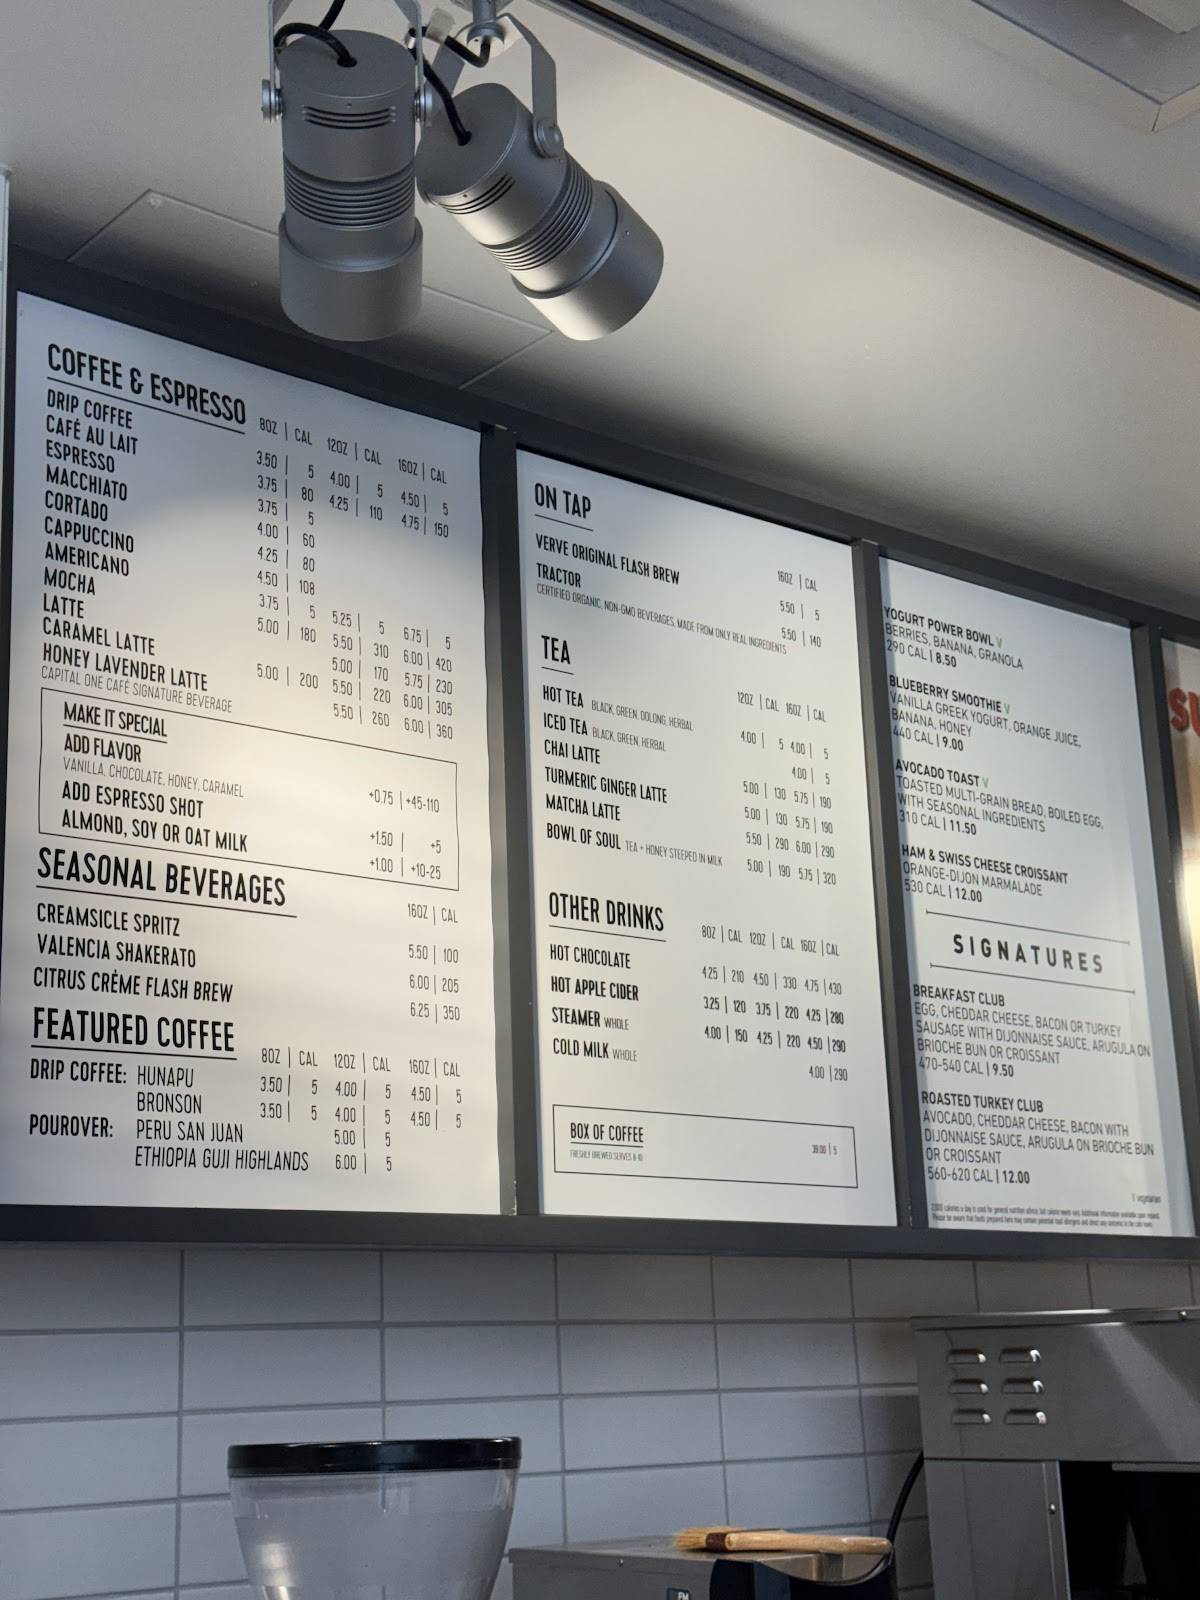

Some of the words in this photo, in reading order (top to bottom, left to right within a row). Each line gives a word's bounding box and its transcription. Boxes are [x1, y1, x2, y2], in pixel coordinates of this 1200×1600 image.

[47, 343, 123, 390] COFFEE
[129, 367, 144, 395] &
[150, 372, 246, 425] ESPRESSO
[47, 388, 79, 414] DRIP
[83, 399, 133, 430] COFFEE
[85, 425, 105, 447] AU
[110, 431, 139, 455] LAIT
[294, 427, 313, 446] CAL
[364, 448, 382, 466] CAL
[46, 439, 115, 473] ESPRESSO
[46, 463, 128, 502] MACCHIATO
[256, 449, 278, 470] 3.50
[329, 471, 351, 489] 4.00
[400, 490, 420, 509] 4.50
[44, 489, 108, 522] CORTADO
[534, 482, 558, 511] ON
[562, 489, 592, 519] TAP
[44, 515, 134, 554] CAPPUCCINO
[44, 541, 130, 577] AMERICANO
[535, 533, 569, 557] VERVE
[571, 543, 618, 570] ORIGINAL
[620, 556, 650, 578] FLASH
[652, 564, 680, 585] BREW
[44, 566, 96, 596] MOCHA
[536, 562, 581, 589] TRACTOR
[804, 577, 818, 593] CAL
[43, 592, 84, 619] LATTE
[43, 616, 111, 647] CARAMEL
[116, 631, 155, 656] LATTE
[883, 606, 925, 628] YOGURT
[927, 617, 964, 639] POWER
[965, 628, 995, 647] BOWL
[541, 634, 571, 665] TEA
[885, 622, 931, 647] BERRIES,
[933, 634, 977, 659] BANANA,
[978, 647, 1024, 670] GRANOLA
[886, 638, 906, 655] 290
[907, 644, 928, 661] CAL
[935, 651, 957, 668] 8.50
[43, 642, 90, 669] HONEY
[95, 652, 166, 684] LAVENDER
[170, 667, 208, 692] LATTE
[41, 664, 81, 686] CAPITAL
[84, 672, 104, 690] ONE
[132, 681, 184, 705] SIGNATURE
[186, 691, 232, 714] BEVERAGE
[542, 684, 562, 704] HOT
[565, 689, 584, 709] TEA
[889, 674, 949, 700] BLUEBERRY
[951, 689, 1002, 714] SMOOTHIE
[64, 701, 101, 726] MAKE
[104, 708, 116, 728] IT
[118, 711, 168, 738] SPECIAL
[371, 710, 390, 727] 260
[436, 723, 453, 740] 360
[543, 712, 567, 732] ICED
[569, 717, 588, 736] TEA
[64, 732, 90, 755] ADD
[93, 737, 142, 763] FLAVOR
[544, 738, 569, 759] CHAI
[571, 744, 601, 765] LATTE
[942, 735, 964, 752] 9.00
[544, 766, 597, 791] TURMERIC
[600, 776, 637, 798] GINGER
[639, 784, 668, 804] LATTE
[895, 759, 945, 780] AVOCADO
[946, 769, 980, 787] TOAST
[62, 780, 91, 802] ADD
[96, 784, 165, 814] ESPRESSO
[169, 796, 204, 819] SHOT
[545, 793, 589, 816] MATCHA
[592, 801, 621, 822] LATTE
[897, 792, 924, 809] WITH
[926, 797, 981, 821] SEASONAL
[982, 809, 1046, 833] INGREDIENTS
[61, 808, 128, 838] ALMOND,
[131, 818, 158, 840] SOY
[162, 823, 180, 844] OR
[185, 826, 211, 847] OAT
[215, 830, 247, 853] MILK
[546, 822, 577, 843] BOWL
[580, 827, 593, 845] OF
[595, 830, 622, 850] SOUL
[949, 819, 977, 836] 11.50
[37, 846, 157, 891] SEASONAL
[165, 863, 286, 907] BEVERAGES
[901, 844, 926, 860] HAM
[928, 848, 936, 862] &
[938, 850, 972, 868] SWISS
[973, 856, 1013, 875] CHEESE
[1014, 863, 1068, 884] CROISSANT
[902, 860, 980, 886] ORANGE-DIJON
[981, 874, 1043, 897] MARMALADE
[955, 886, 983, 903] 12.00
[37, 902, 128, 932] CREAMSICLE
[133, 913, 180, 937] SPRITZ
[549, 891, 600, 923] OTHER
[606, 899, 664, 932] DRINKS
[37, 933, 111, 960] VALENCIA
[115, 941, 196, 968] SHAKERATO
[408, 943, 429, 961] 5.50
[443, 947, 459, 964] 100
[549, 943, 570, 962] HOT
[573, 946, 631, 969] CHOCOLATE
[953, 933, 1103, 974] SIGNATURES
[33, 966, 86, 991] CITRUS
[145, 976, 189, 1000] FLASH
[193, 980, 233, 1003] BREW
[551, 975, 571, 994] HOT
[574, 978, 606, 998] APPLE
[609, 982, 639, 1001] CIDER
[702, 965, 718, 981] 4.25
[731, 969, 745, 984] 210
[913, 984, 976, 1004] BREAKFAST
[978, 991, 1006, 1007] CLUB
[33, 1006, 148, 1046] FEATURED
[157, 1016, 235, 1052] COFFEE
[551, 1006, 601, 1028] STEAMER
[603, 1016, 629, 1031] WHOLE
[552, 1037, 580, 1057] COLD
[583, 1040, 609, 1059] MILK
[611, 1048, 637, 1062] WHOLE
[916, 1037, 963, 1056] BRIOCHE
[964, 1042, 987, 1058] BUN
[989, 1044, 1004, 1059] OR
[1005, 1046, 1061, 1065] CROISSANT
[30, 1058, 65, 1081] DRIP
[70, 1060, 127, 1084] COFFEE:
[137, 1065, 194, 1088] HUNAPU
[918, 1055, 962, 1073] 470-540
[963, 1059, 985, 1075] CAL
[992, 1062, 1015, 1078] 9.50
[137, 1091, 202, 1114] BRONSON
[921, 1090, 972, 1108] ROASTED
[972, 1095, 1014, 1111] TURKEY
[1016, 1098, 1044, 1113] CLUB
[29, 1113, 113, 1138] POUROVER:
[136, 1118, 172, 1141] PERU
[177, 1120, 205, 1142] SAN
[210, 1122, 243, 1143] JUAN
[570, 1122, 590, 1140] BOX
[592, 1123, 605, 1141] OF
[608, 1124, 644, 1143] COFFEE
[135, 1145, 197, 1168] ETHIOPIA
[202, 1147, 230, 1169] GUJI
[235, 1149, 309, 1172] HIGHLANDS
[925, 1146, 942, 1162] OR
[943, 1147, 1002, 1164] CROISSANT
[927, 1165, 971, 1182] 560-620
[972, 1167, 994, 1183] CAL
[1002, 1169, 1031, 1185] 12.00
